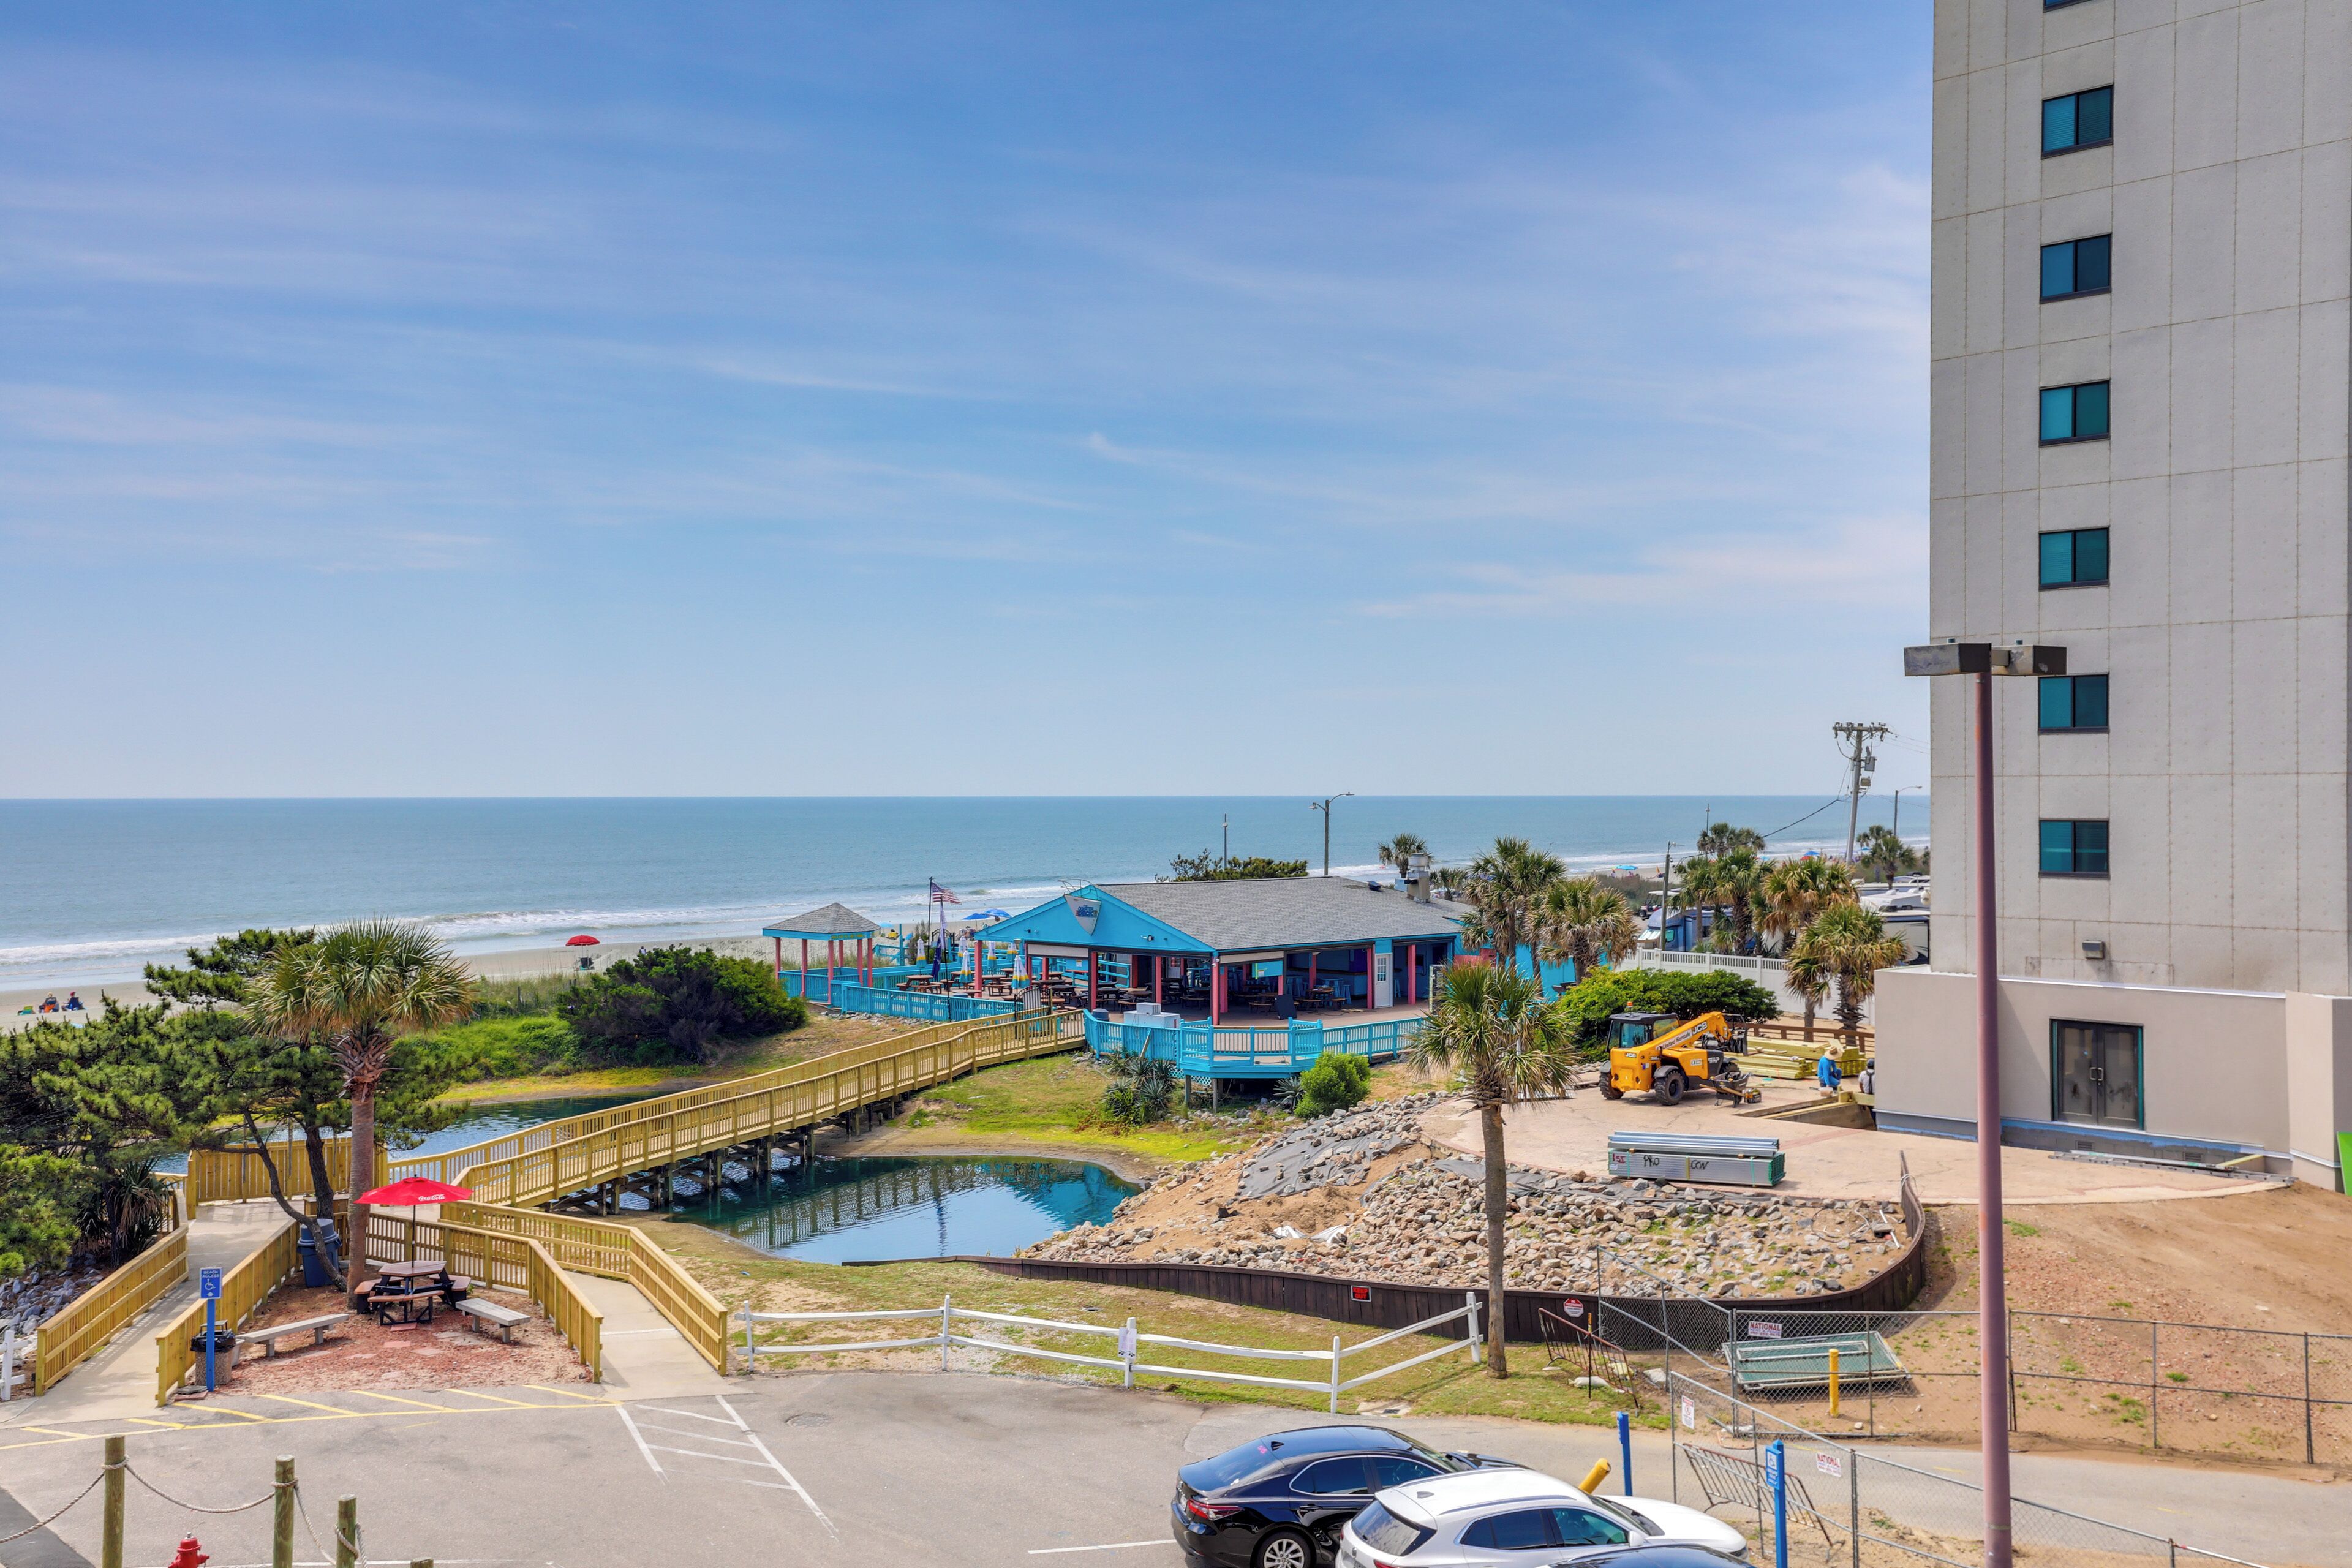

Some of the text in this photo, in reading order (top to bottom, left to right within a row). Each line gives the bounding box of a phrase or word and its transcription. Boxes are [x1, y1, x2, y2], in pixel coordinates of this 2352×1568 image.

[1692, 1022, 1708, 1035] JCB
[1750, 1322, 1781, 1331] NATIONAL
[1817, 1453, 1840, 1468] NATIONAL
